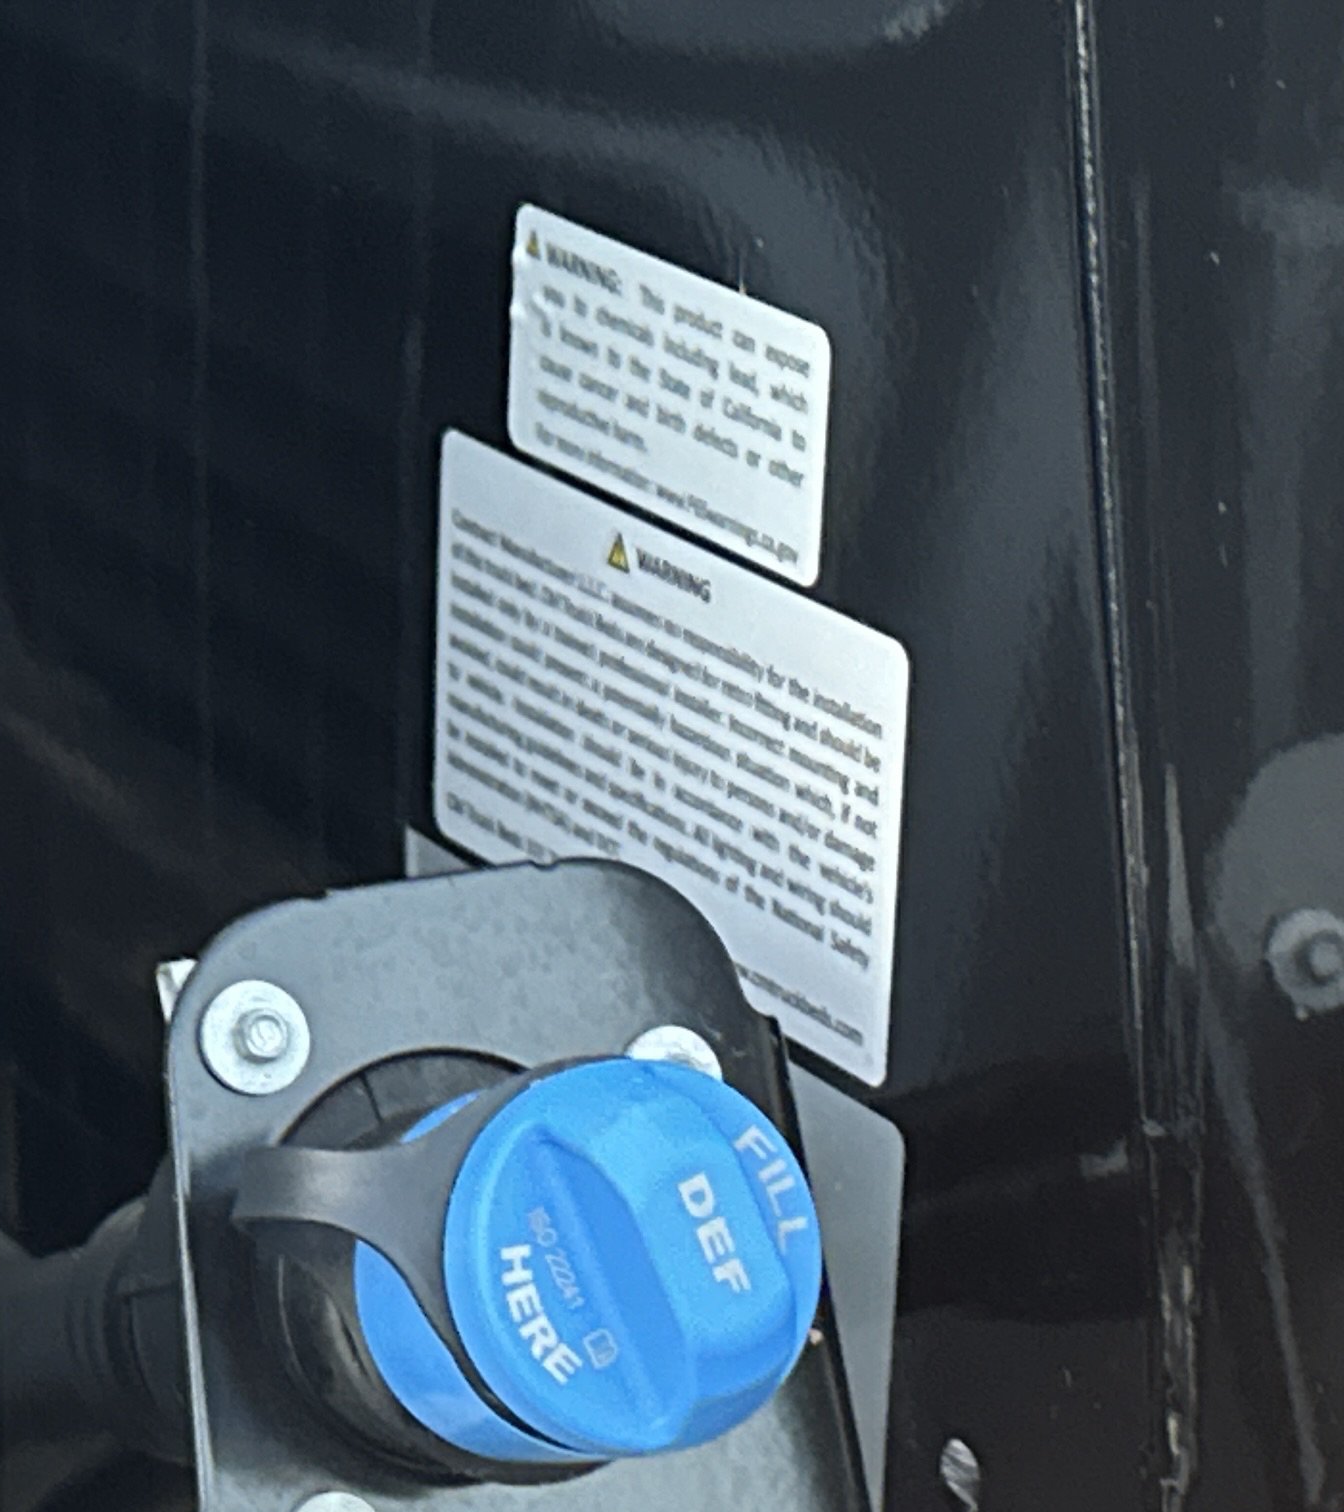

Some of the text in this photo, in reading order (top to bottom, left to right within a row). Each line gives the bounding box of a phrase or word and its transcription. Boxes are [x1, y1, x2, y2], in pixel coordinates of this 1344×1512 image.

[546, 243, 620, 295] WARNING:
[732, 330, 754, 353] can
[723, 397, 781, 441] California
[637, 548, 709, 602] WARNING
[789, 678, 809, 703] the
[813, 690, 881, 738] installation
[820, 728, 861, 762] should
[864, 747, 880, 772] be
[854, 781, 878, 805] and
[854, 815, 877, 838] not
[733, 1124, 808, 1255] FILL
[678, 1171, 751, 1294] DEF
[500, 1244, 583, 1385] HERE
